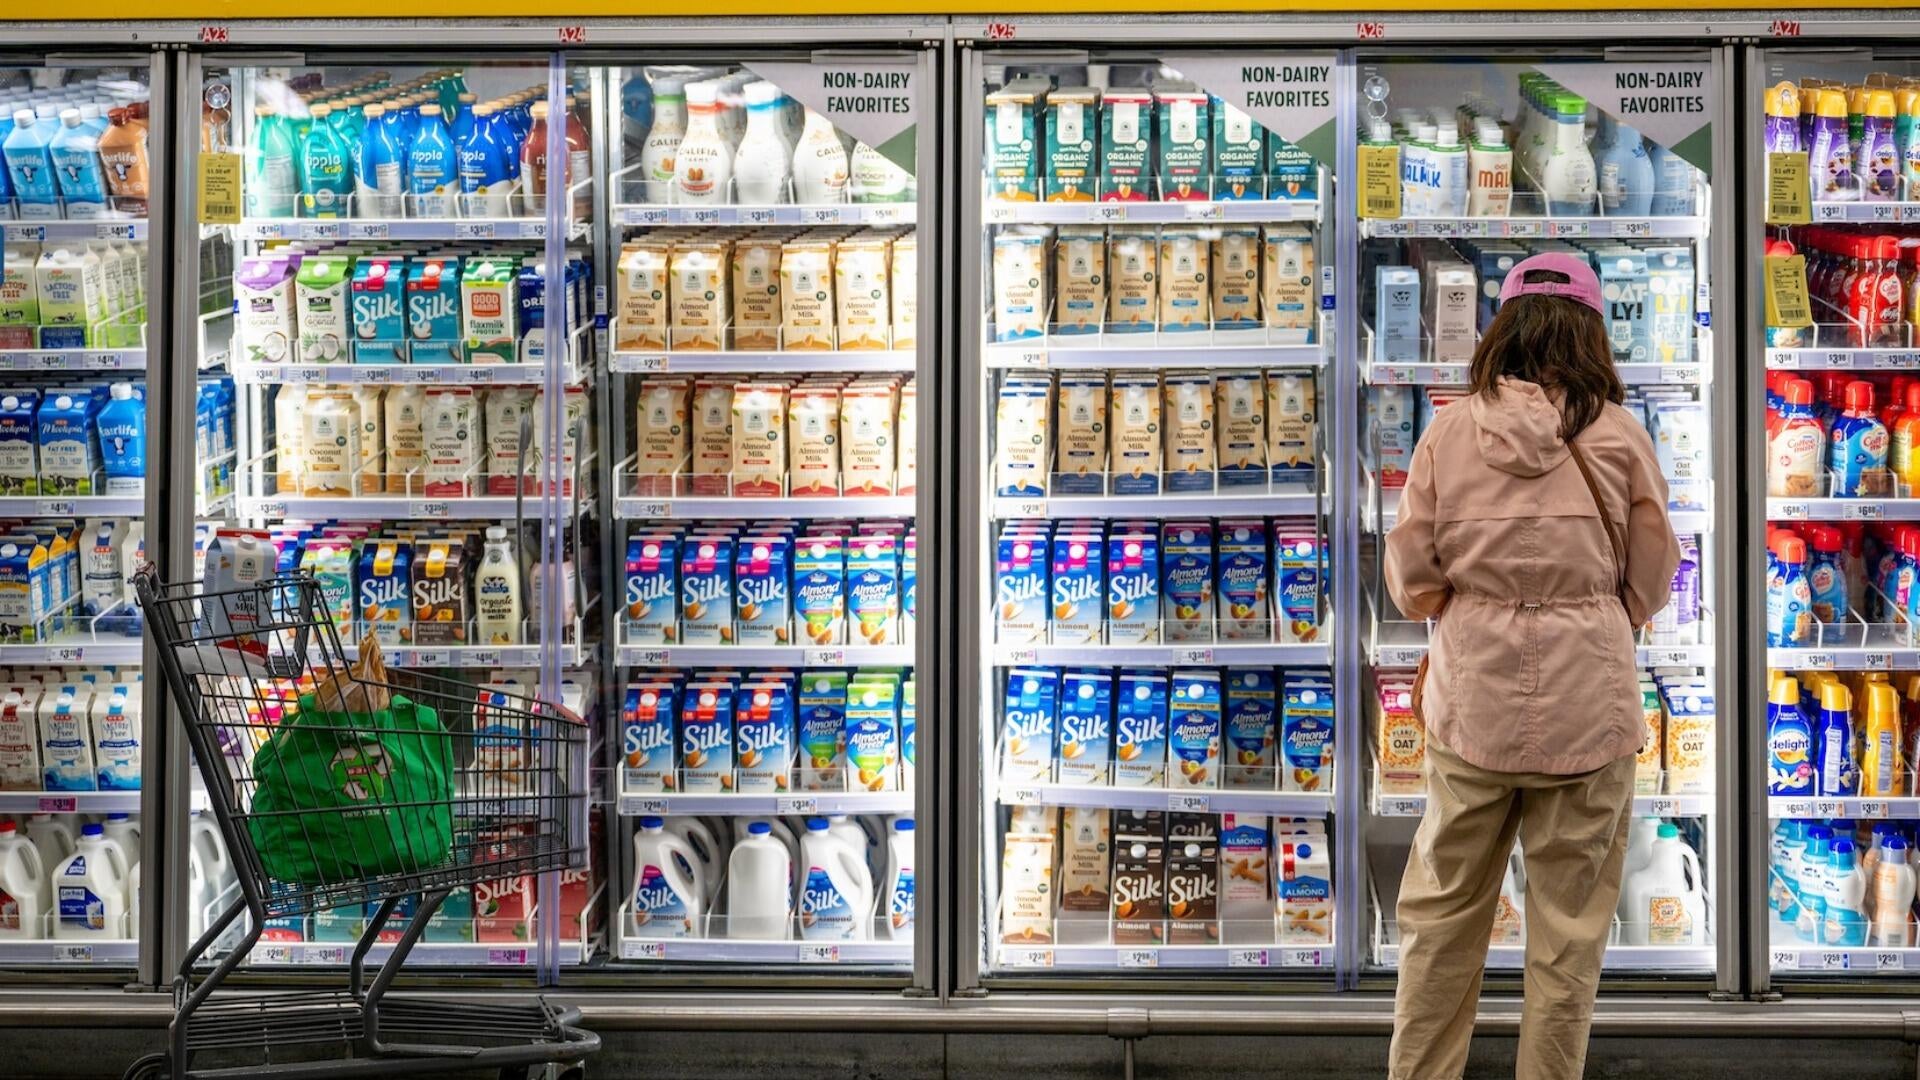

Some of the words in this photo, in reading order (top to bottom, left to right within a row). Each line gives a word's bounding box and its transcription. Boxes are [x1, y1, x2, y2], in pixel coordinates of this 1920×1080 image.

[202, 28, 229, 42] A23
[560, 27, 586, 41] A24
[990, 24, 1016, 38] A25
[1359, 23, 1385, 37] A26
[1705, 26, 1711, 34] 5
[1774, 21, 1799, 35] A27
[823, 72, 911, 89] NON-DAIRY
[1242, 66, 1330, 82] NON-DAIRY
[1616, 72, 1704, 89] NON-DAIRY
[827, 97, 910, 113] FAVORITES
[1246, 91, 1330, 107] FAVORITES
[1620, 97, 1704, 113] FAVORITES
[1051, 152, 1089, 161] ORGANIC
[1107, 152, 1145, 161] ORGANIC
[1165, 152, 1203, 160] ORGANIC
[1219, 152, 1258, 160] ORGANIC
[1478, 169, 1511, 188] MAL
[354, 293, 402, 325] Silk
[409, 292, 457, 325] Silk
[522, 297, 545, 309] DRE
[1611, 302, 1643, 321] LY!
[470, 320, 505, 330] flaxmilk
[361, 578, 408, 609] Silk
[414, 577, 464, 609] Silk
[626, 573, 675, 605] Silk
[682, 574, 731, 606] Silk
[737, 576, 785, 608] Silk
[1000, 573, 1046, 604] Silk
[1053, 574, 1102, 605] Silk
[1109, 573, 1158, 605] Silk
[1005, 710, 1053, 741] Silk
[1061, 715, 1110, 746] Silk
[1116, 717, 1165, 747] Silk
[1174, 722, 1217, 738] Almond
[624, 722, 673, 754] Silk
[682, 722, 732, 754] Silk
[737, 722, 784, 754] Silk
[1287, 729, 1331, 745] Almond
[1393, 740, 1416, 749] OAT
[1682, 742, 1705, 751] OAT
[1226, 837, 1264, 845] ALMOND
[1114, 874, 1163, 906] Silk
[1169, 874, 1217, 906] Silk
[1285, 888, 1325, 897] ALMOND
[636, 886, 678, 912] Silk
[803, 888, 843, 914] Silk
[1117, 922, 1150, 930] Almond
